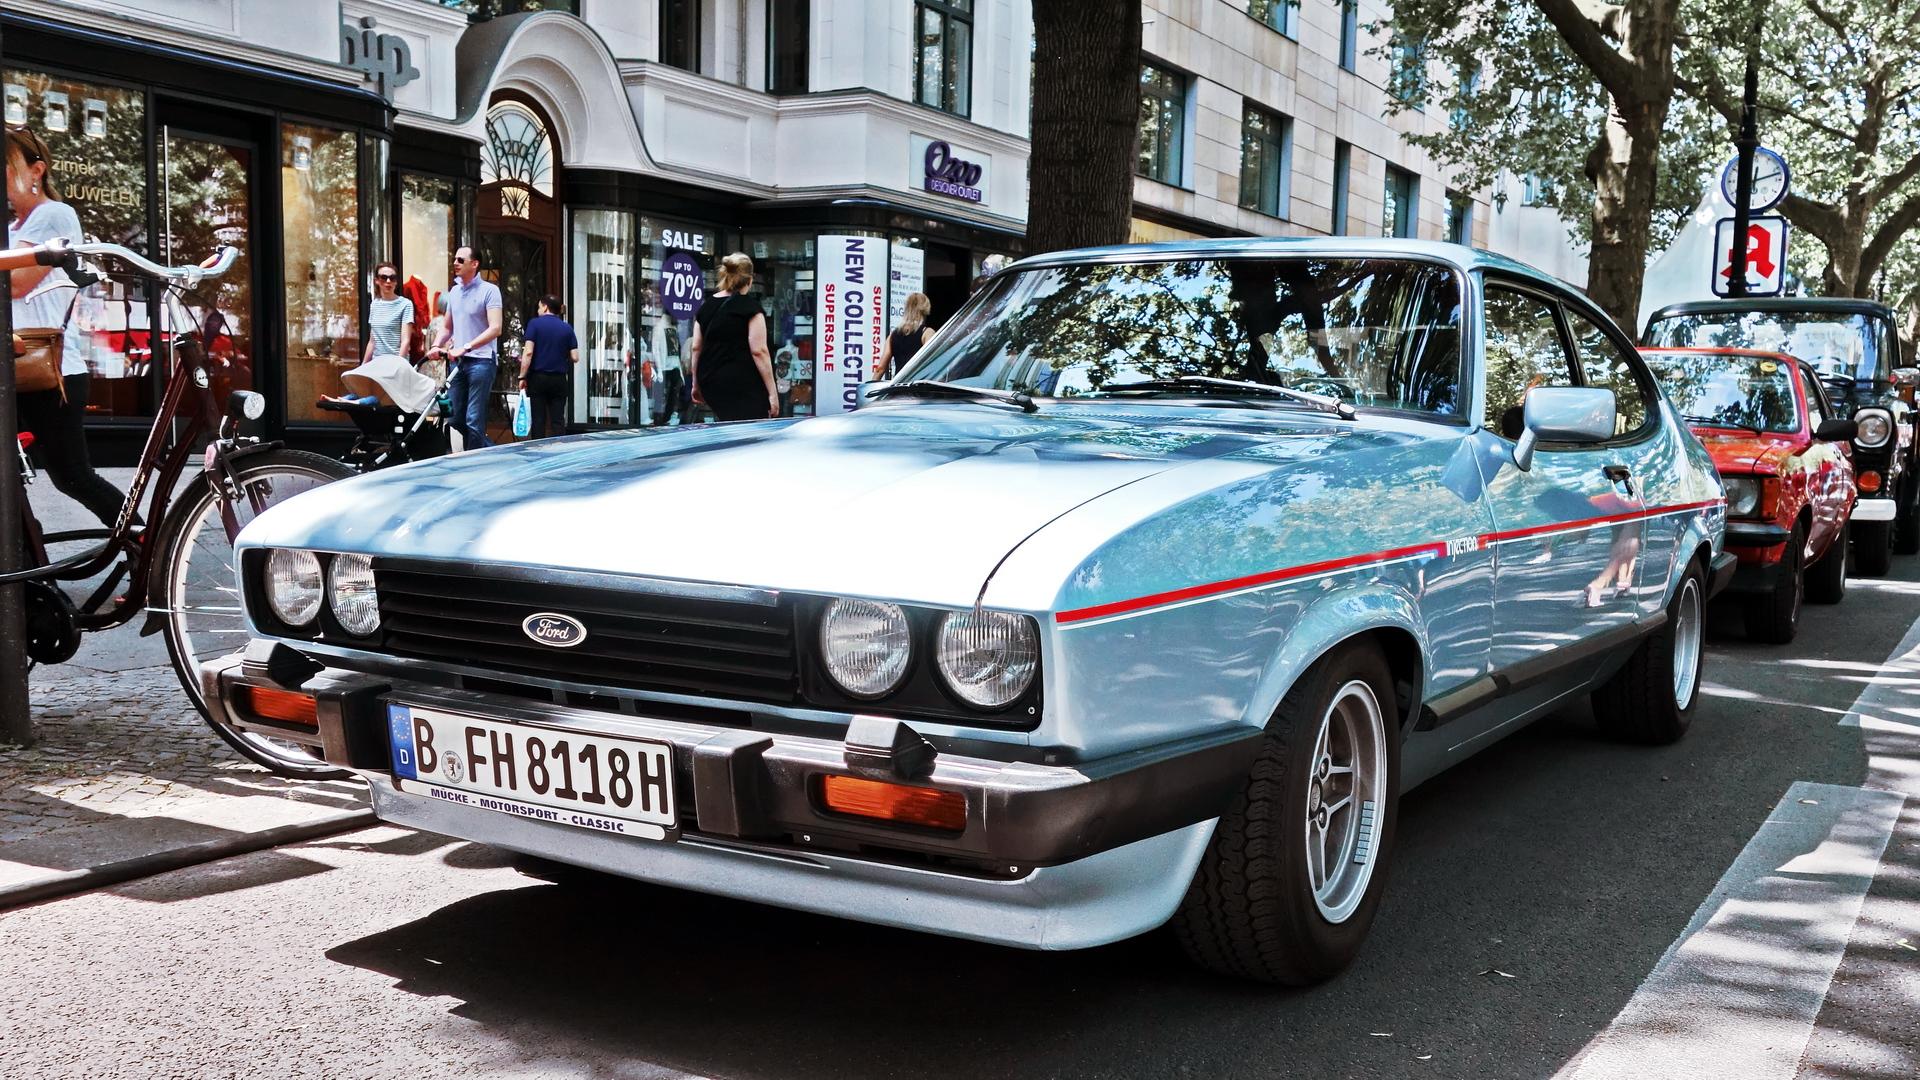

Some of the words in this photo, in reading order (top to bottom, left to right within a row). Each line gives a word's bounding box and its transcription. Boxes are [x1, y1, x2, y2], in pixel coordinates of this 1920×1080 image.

[65, 183, 141, 207] JUWELEN
[930, 179, 957, 196] DESIGNER
[958, 186, 980, 201] OUTLET
[662, 229, 703, 252] SALE
[673, 262, 683, 270] UP
[683, 263, 692, 271] TO
[845, 238, 864, 285] NEW
[662, 271, 703, 301] 70%
[672, 302, 683, 310] BIS
[683, 303, 693, 312] ZU
[824, 283, 836, 372] SUPERSALE
[536, 618, 570, 639] Ford
[399, 748, 409, 765] D
[413, 717, 438, 774] B
[525, 736, 669, 815] 8118H
[430, 787, 469, 804] MÜCKE
[480, 797, 559, 821] MOTORSPORT
[571, 815, 624, 832] CLASSIC
